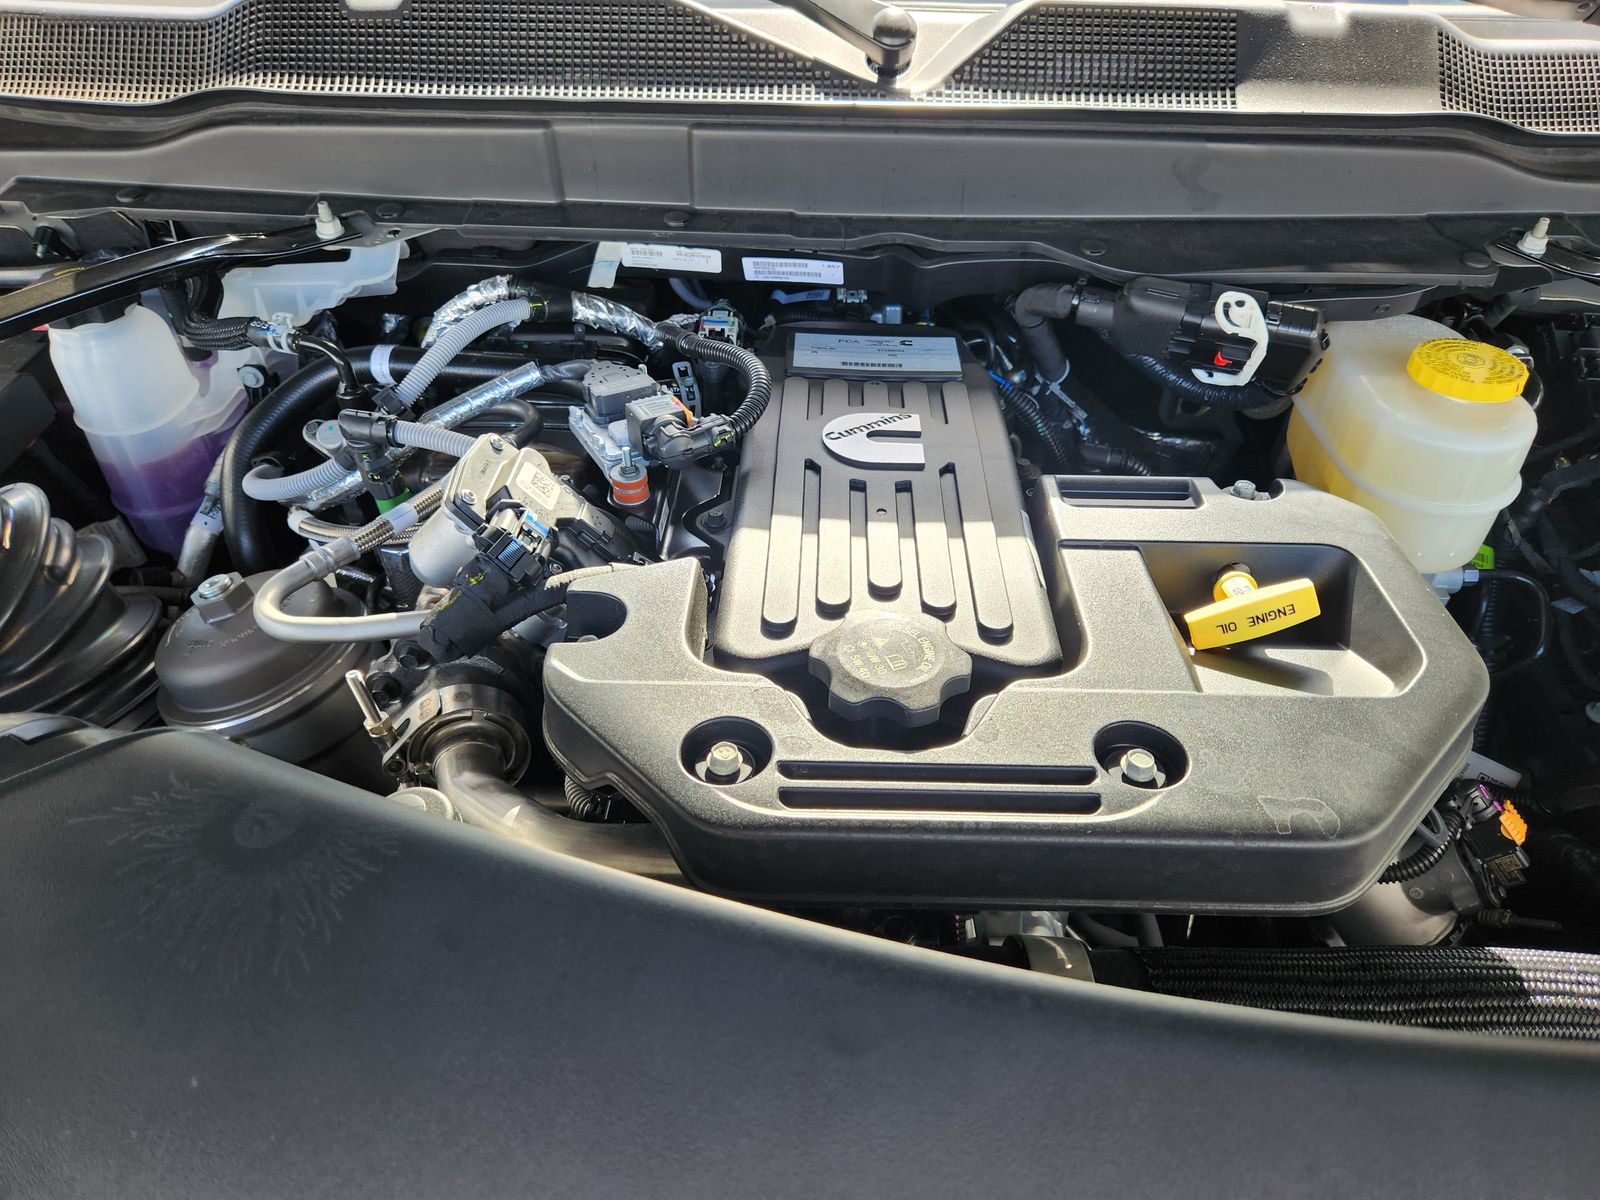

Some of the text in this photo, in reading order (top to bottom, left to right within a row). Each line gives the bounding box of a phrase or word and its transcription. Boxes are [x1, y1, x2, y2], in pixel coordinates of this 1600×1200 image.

[825, 413, 912, 441] Cummins
[889, 622, 920, 639] DIESEL
[1215, 603, 1296, 635] ENGINE OIL
[918, 636, 936, 662] ENGINE
[916, 661, 932, 672] OIL
